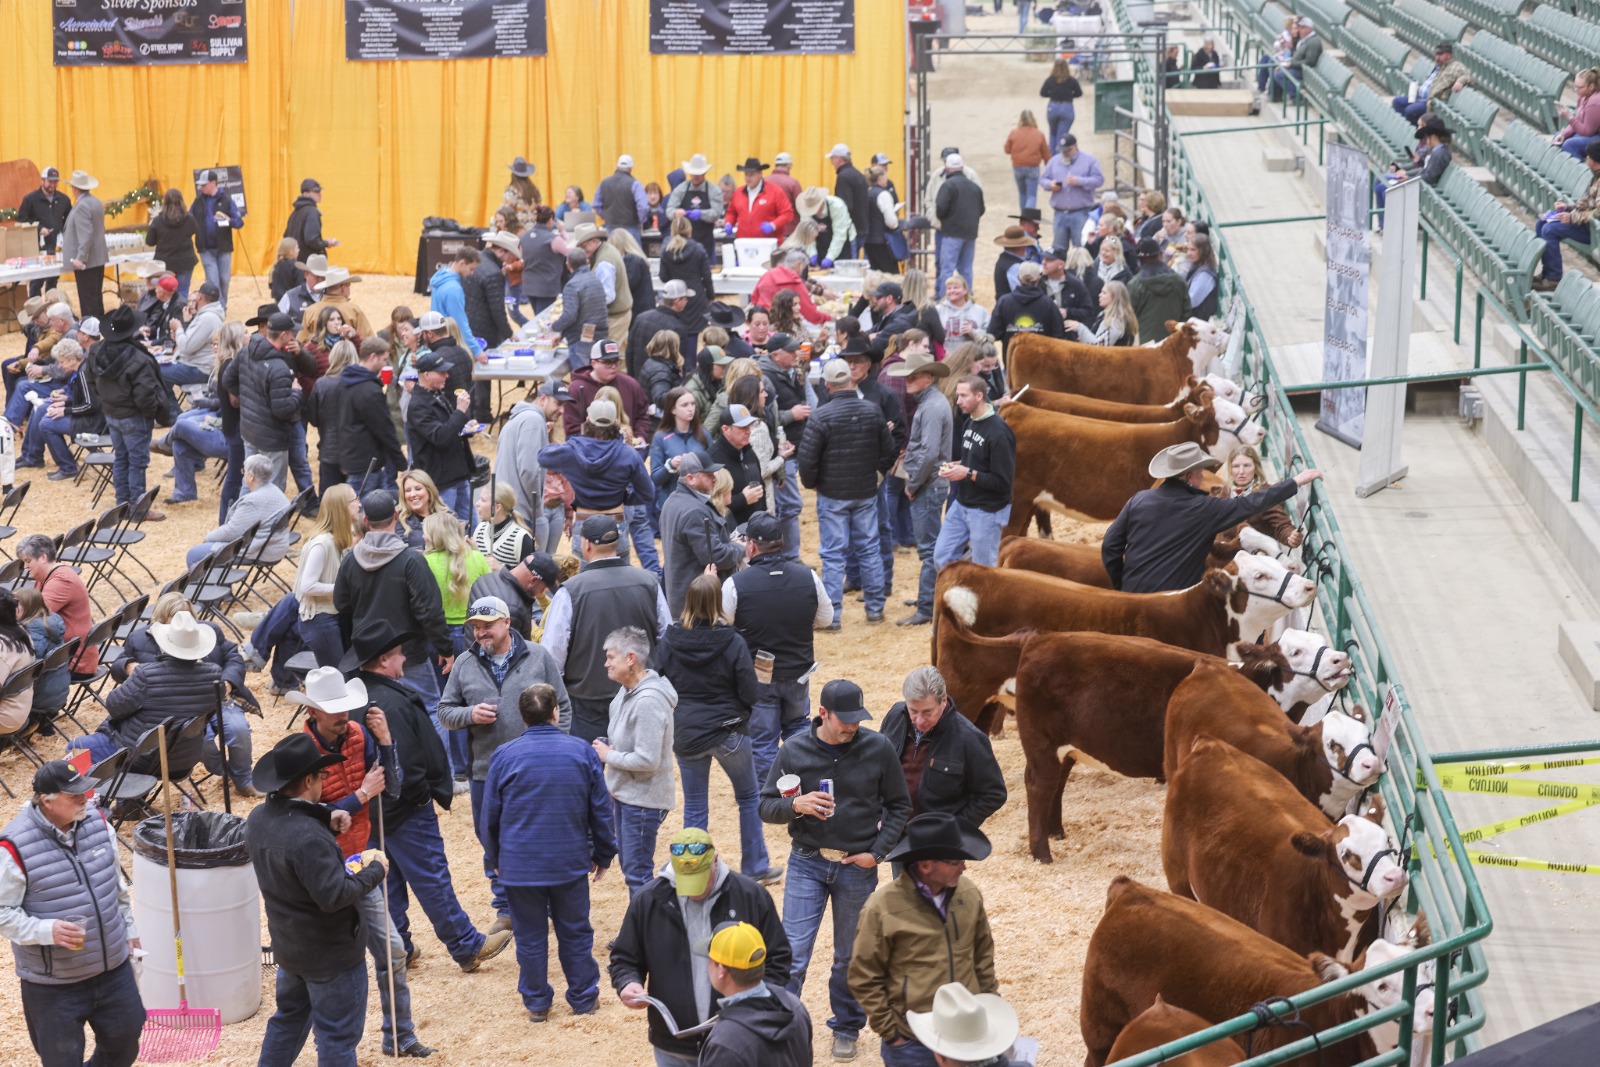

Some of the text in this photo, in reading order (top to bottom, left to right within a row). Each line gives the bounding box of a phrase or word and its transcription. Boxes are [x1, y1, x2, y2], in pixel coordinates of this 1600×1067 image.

[101, 0, 198, 13] Silver Sponsors
[167, 43, 184, 51] SHOW
[210, 37, 243, 47] SULLIVAN
[210, 47, 237, 57] SUPPLY
